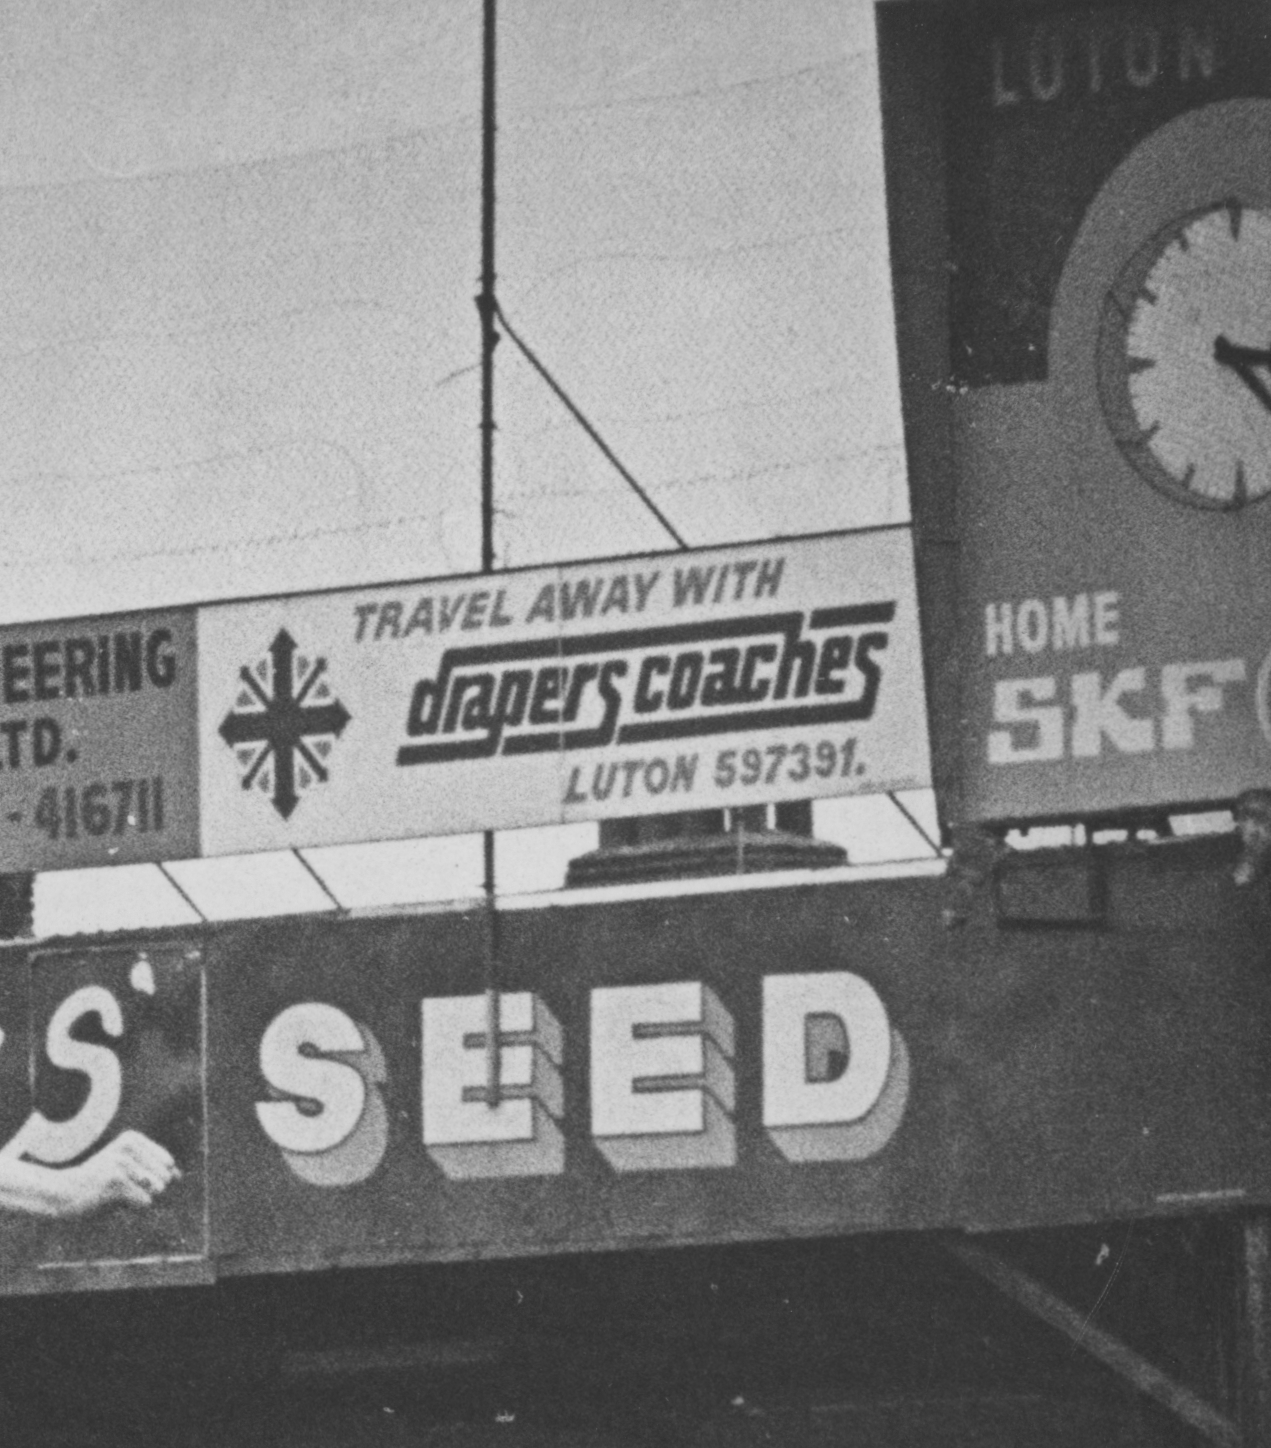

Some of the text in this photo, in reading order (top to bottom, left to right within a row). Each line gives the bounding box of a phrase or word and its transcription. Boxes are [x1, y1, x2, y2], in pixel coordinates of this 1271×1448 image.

[993, 25, 1214, 106] LUTON
[354, 557, 785, 643] TRAVEL AWAY WITH
[985, 591, 1119, 655] HOME
[404, 612, 890, 755] drapers coaches
[988, 660, 1245, 765] SKF
[561, 737, 865, 805] LUTON 597391.
[256, 971, 909, 1187] SEED
